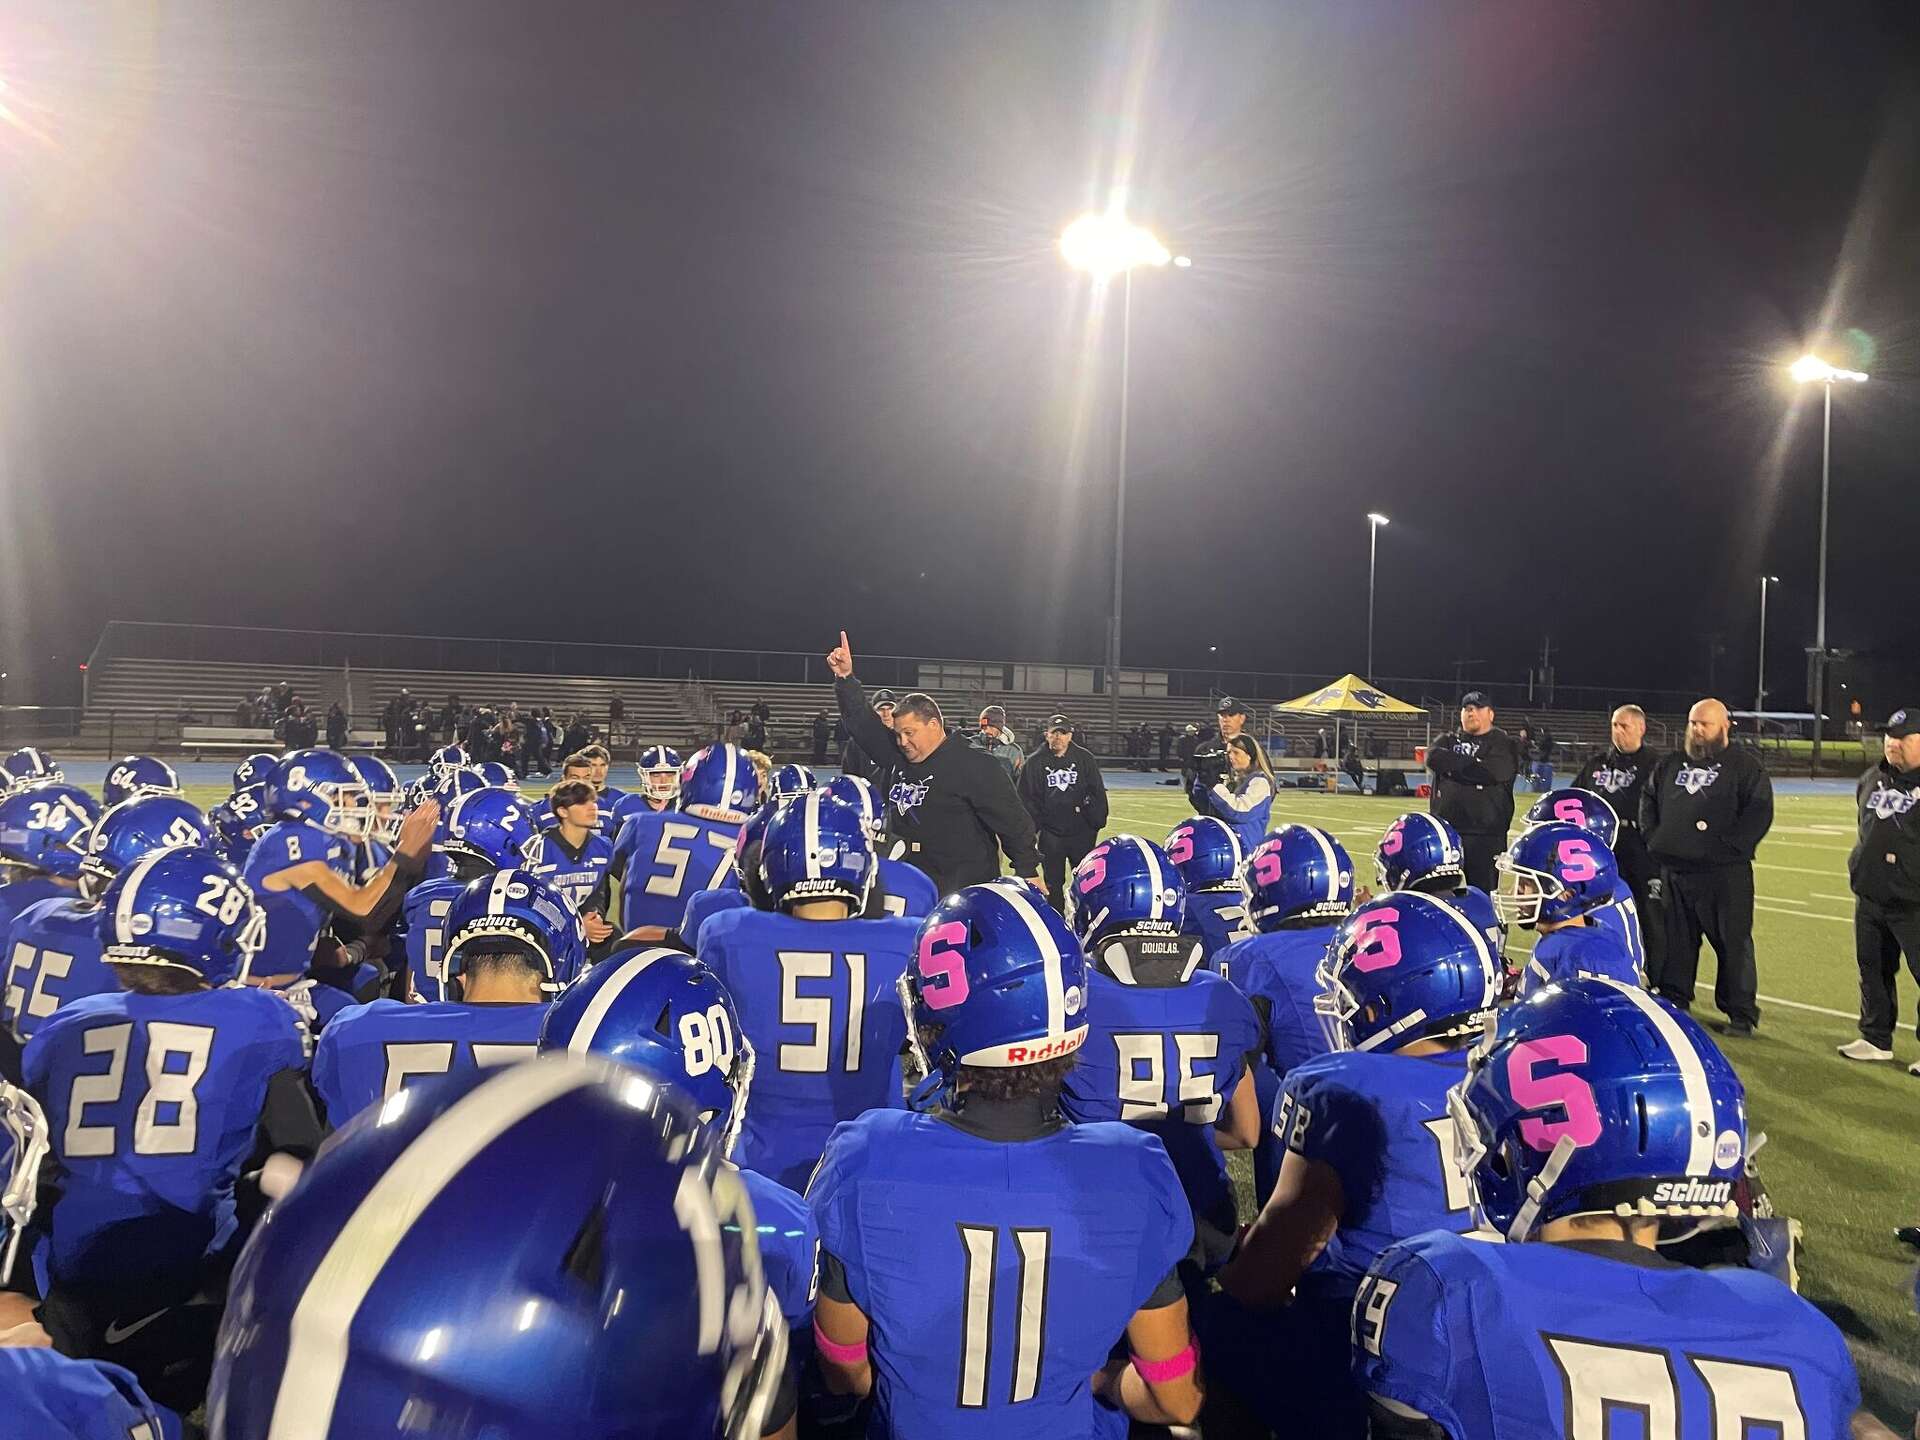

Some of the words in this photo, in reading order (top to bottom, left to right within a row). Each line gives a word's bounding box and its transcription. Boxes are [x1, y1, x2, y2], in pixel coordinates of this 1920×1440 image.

[889, 783, 929, 806] BKF
[1049, 771, 1078, 787] BKF
[1676, 771, 1719, 786] BKF
[27, 802, 71, 831] 34
[501, 805, 520, 832] 2
[1554, 799, 1586, 826] S
[286, 836, 302, 861] 8
[1166, 826, 1195, 865] S
[1381, 820, 1405, 856] S
[645, 822, 738, 898] 57
[1073, 844, 1111, 894] S
[1252, 838, 1283, 887] S
[1558, 839, 1597, 882] S
[196, 874, 246, 926] 28
[795, 878, 837, 892] schutt
[467, 914, 518, 931] schutt
[1136, 918, 1174, 932] schutt
[1316, 900, 1348, 912] schutt
[1353, 906, 1402, 973] S
[918, 921, 970, 1010] S
[777, 951, 866, 1073] 51
[678, 1003, 733, 1077] 80
[1008, 1030, 1086, 1063] Riddell
[64, 1021, 215, 1157] 28
[1113, 1034, 1222, 1124] 95
[1507, 1034, 1603, 1152] S
[1273, 1090, 1312, 1153] 58
[1653, 1177, 1731, 1203] schutt
[957, 1223, 1052, 1410] 11
